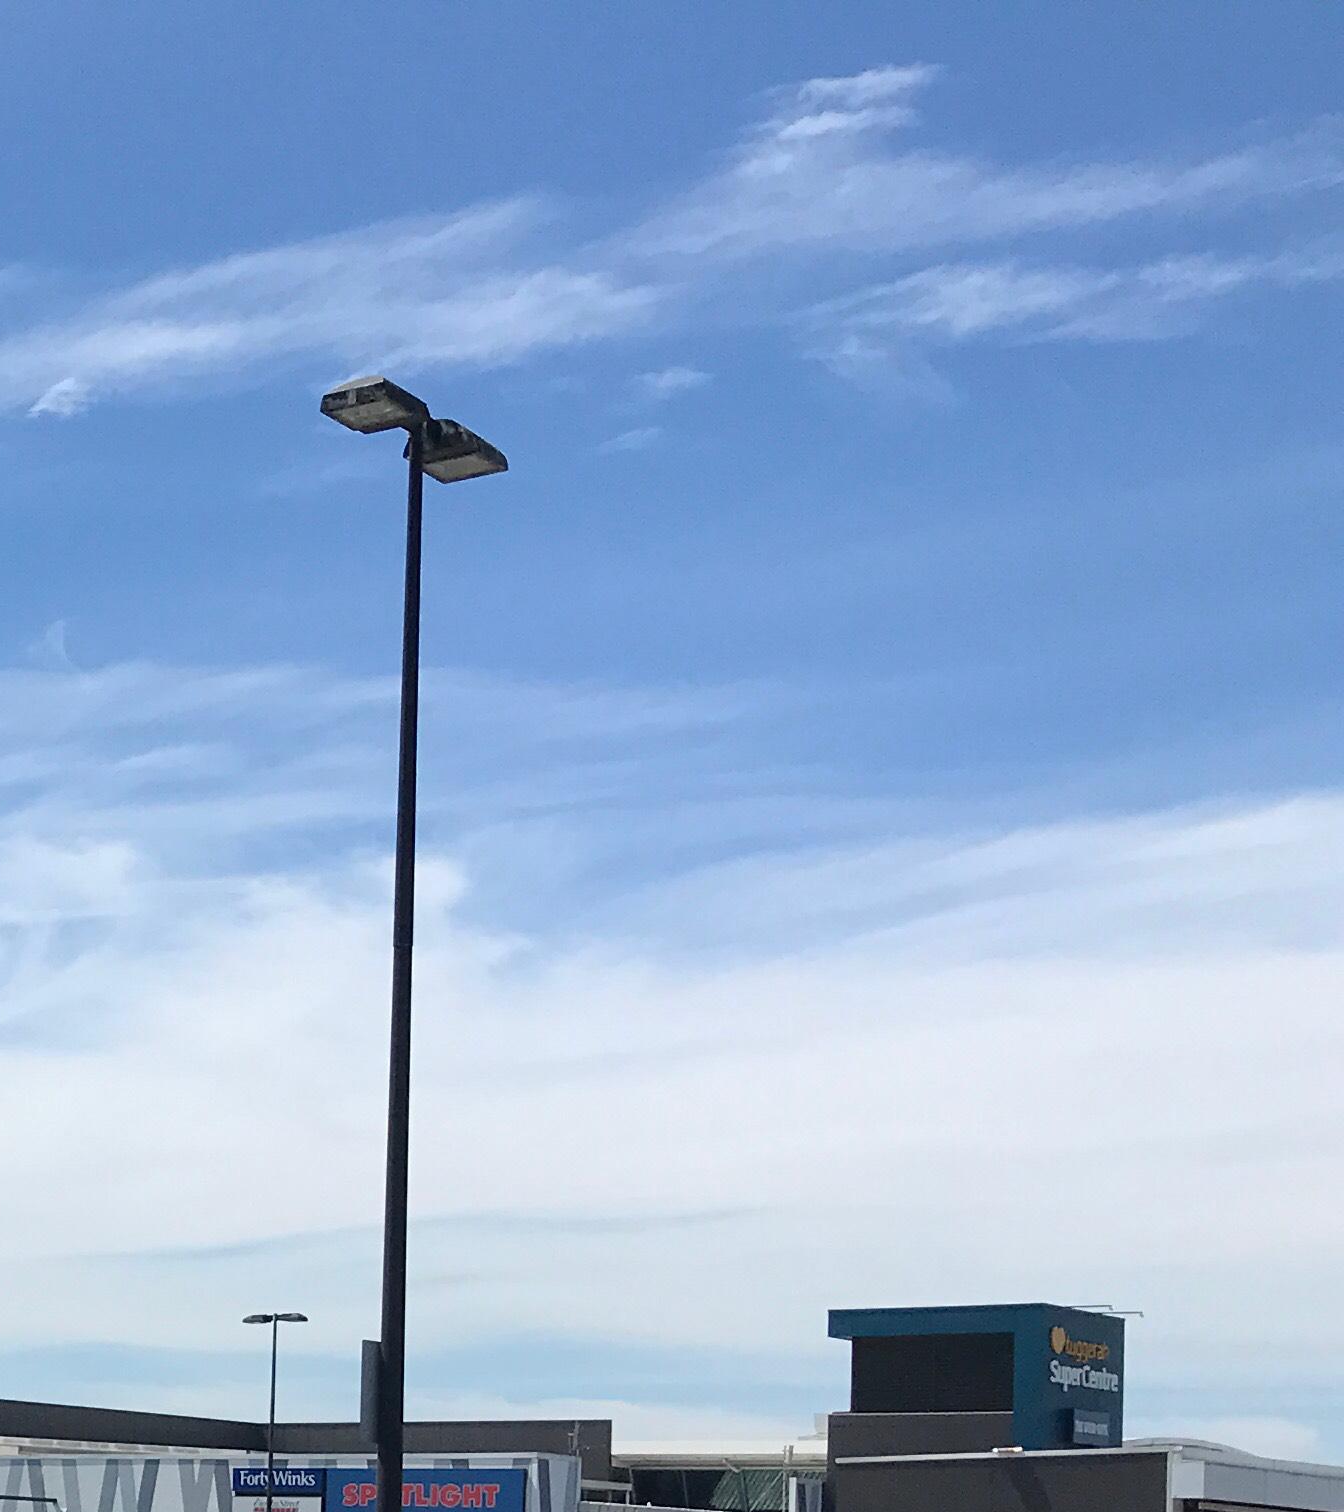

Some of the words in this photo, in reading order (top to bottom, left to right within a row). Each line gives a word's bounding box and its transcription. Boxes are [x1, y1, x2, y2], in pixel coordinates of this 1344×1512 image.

[1050, 1359, 1119, 1393] SuperCentre
[272, 1470, 316, 1486] Winks
[342, 1483, 500, 1508] SPTLIGHT
